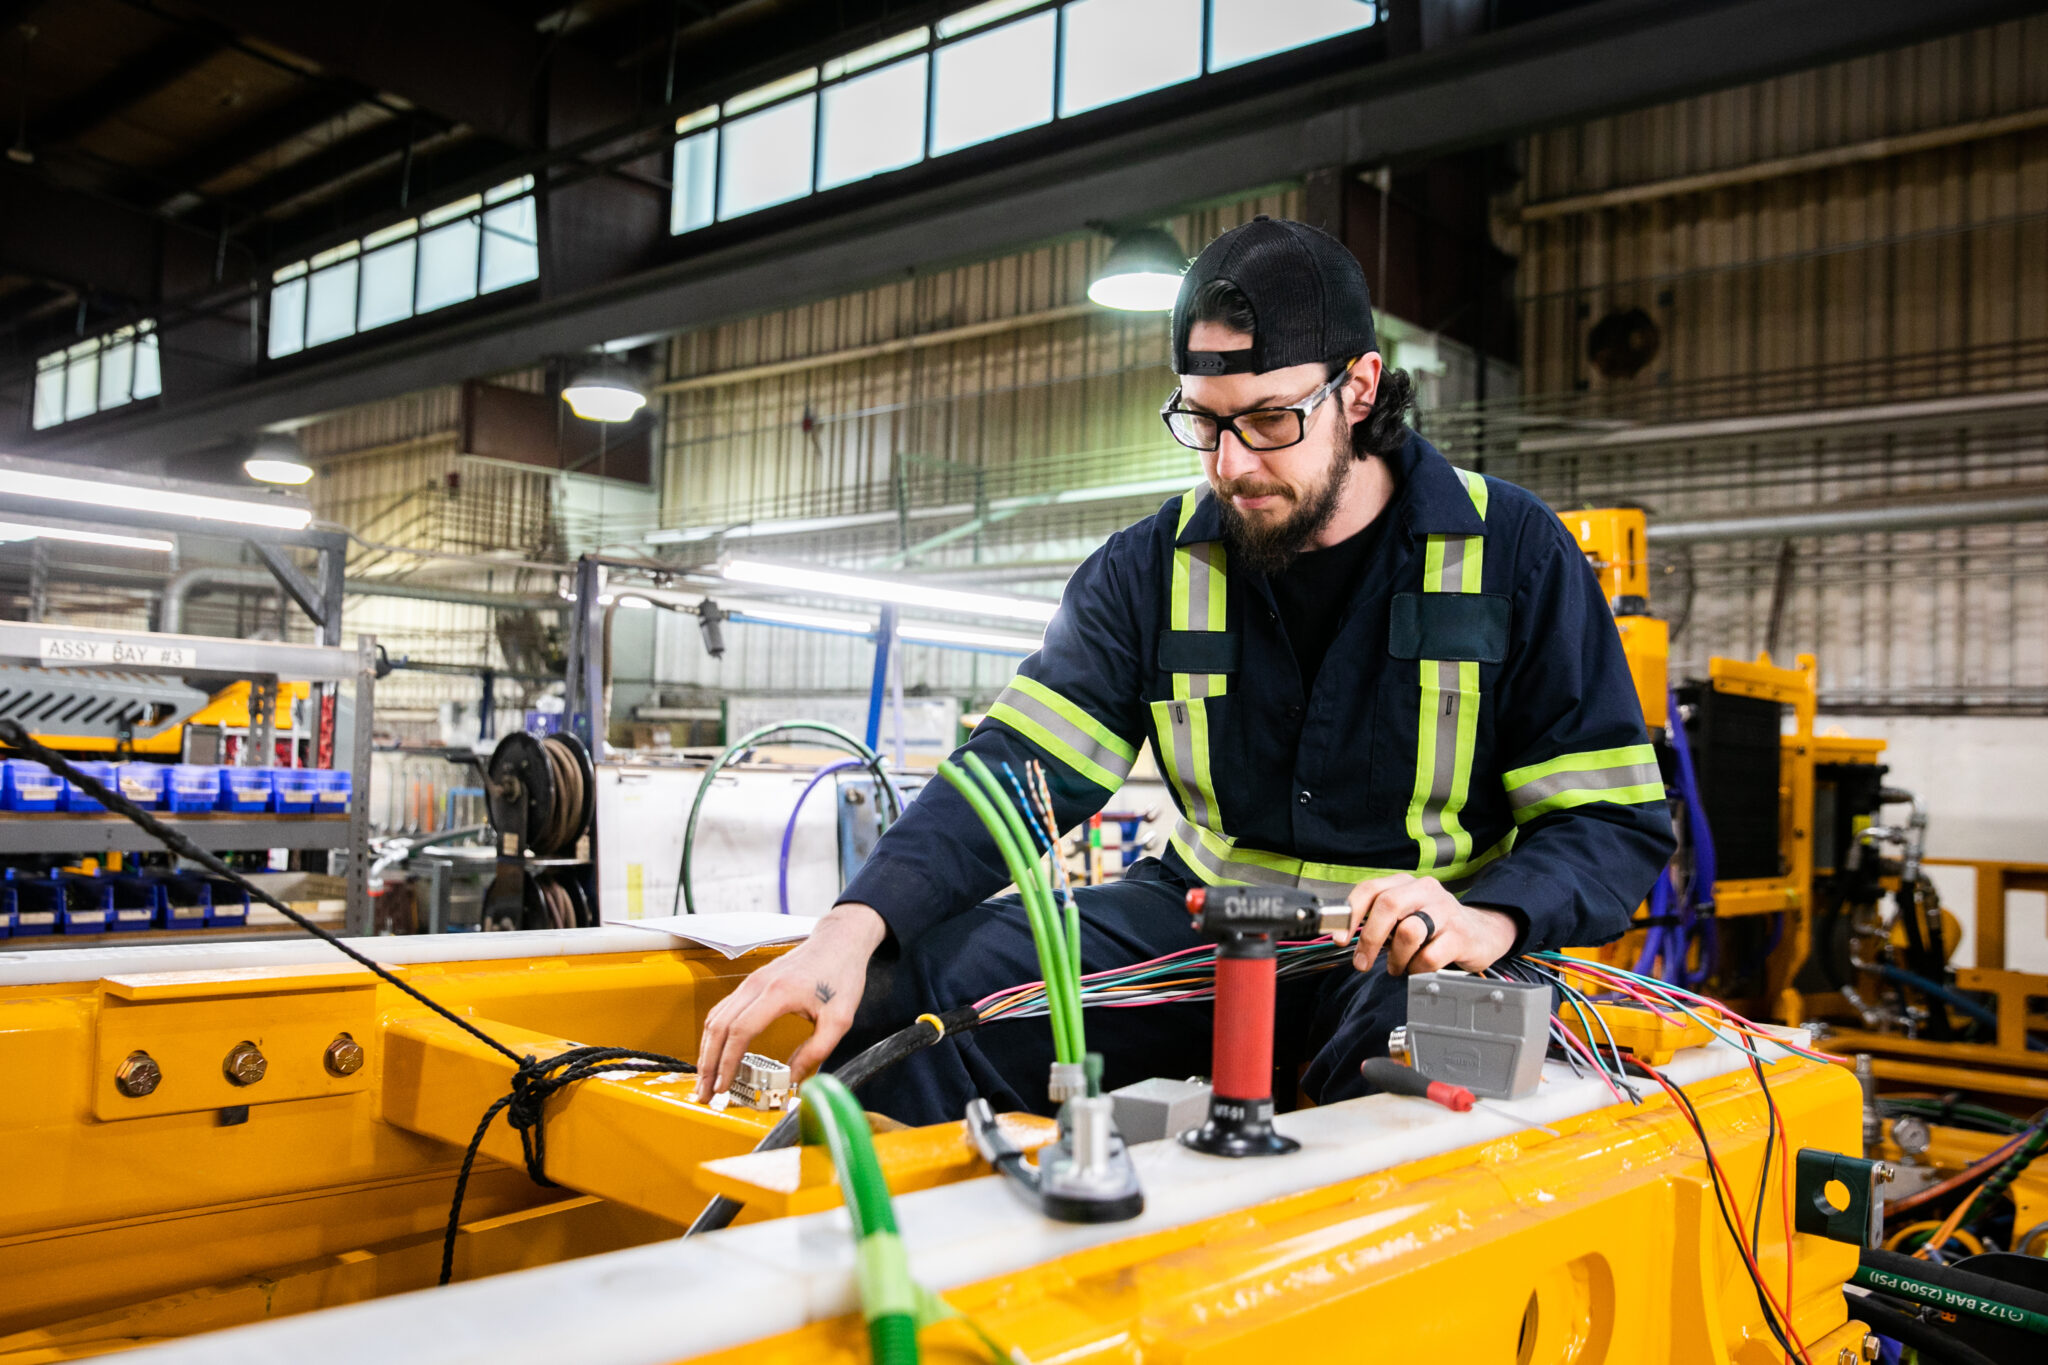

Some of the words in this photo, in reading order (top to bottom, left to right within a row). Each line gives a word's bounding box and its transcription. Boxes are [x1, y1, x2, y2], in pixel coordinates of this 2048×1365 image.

[49, 640, 99, 659] ASSY
[113, 642, 148, 662] BAY
[160, 649, 183, 665] #3
[1869, 1271, 1898, 1289] PSI)
[1900, 1280, 1943, 1301] (2500
[1945, 1292, 1977, 1310] BAR
[1979, 1301, 2006, 1318] 172
